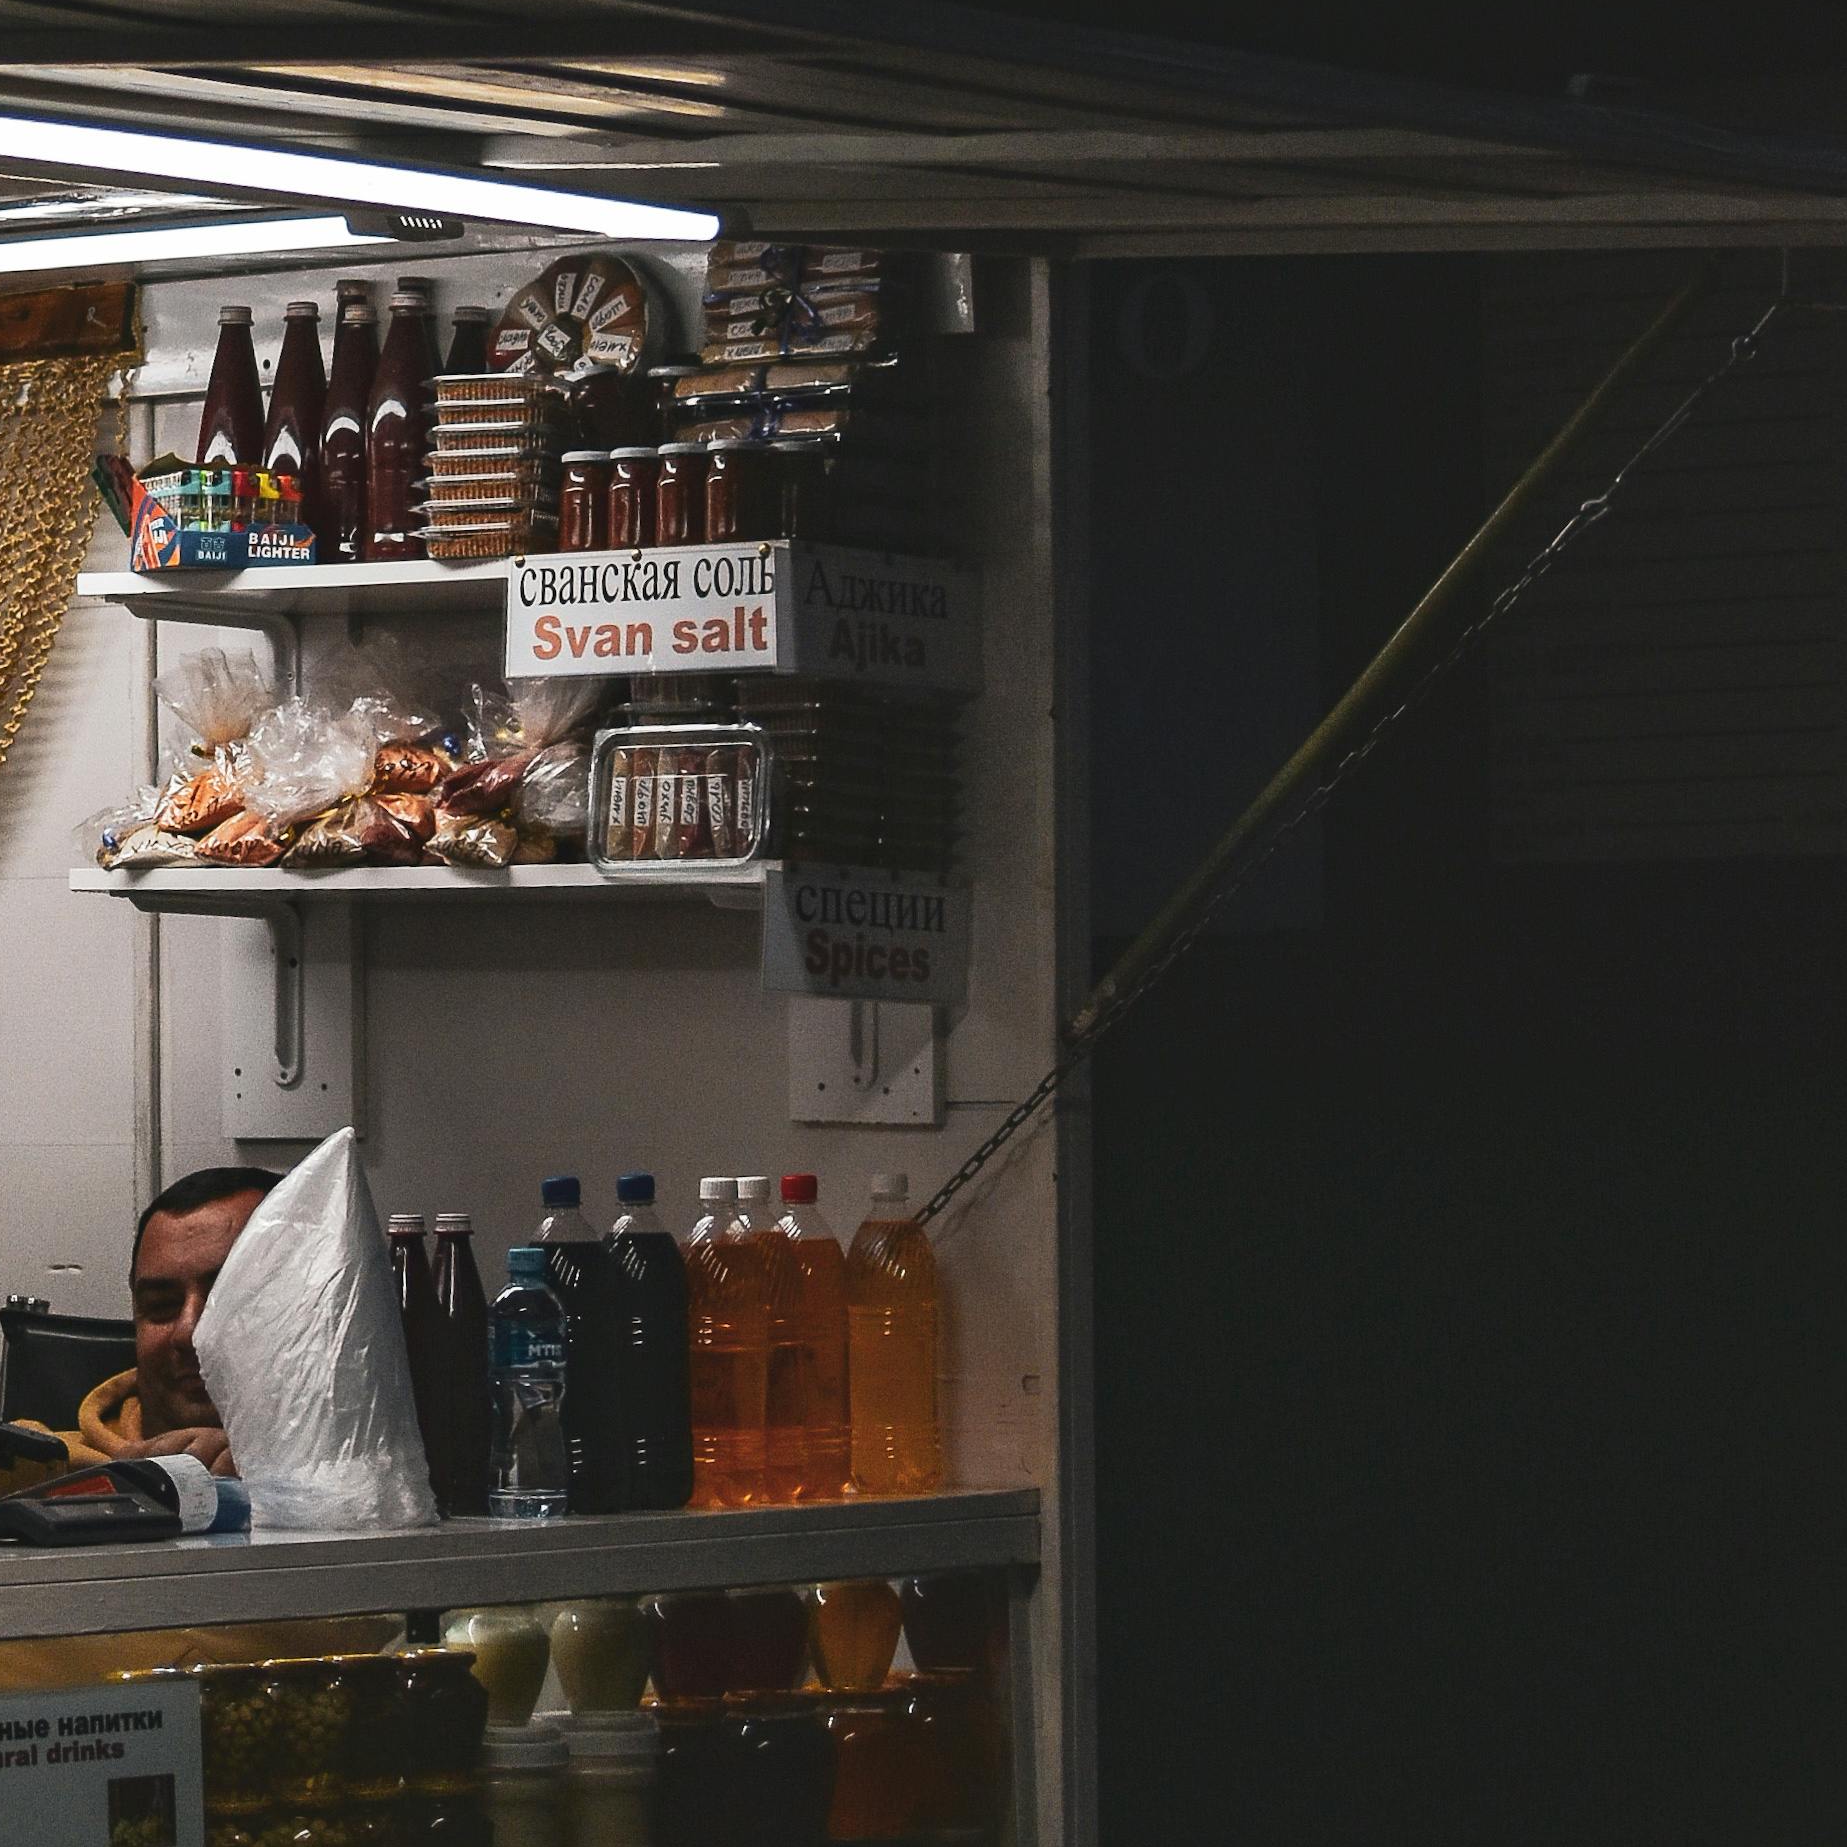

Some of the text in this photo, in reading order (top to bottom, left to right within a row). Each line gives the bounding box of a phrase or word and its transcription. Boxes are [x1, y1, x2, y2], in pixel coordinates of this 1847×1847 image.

[197, 551, 227, 561] BAIJI
[248, 533, 296, 546] BAIJI
[248, 546, 310, 561] LIGHTER
[518, 546, 776, 609] сванская соль
[804, 566, 948, 621] Аджика
[532, 606, 768, 662] Svan salt
[828, 620, 926, 672] Ajika
[794, 881, 948, 935] специи
[805, 928, 932, 986] Spices
[58, 1709, 163, 1737] напитки
[46, 1737, 125, 1764] drinks
